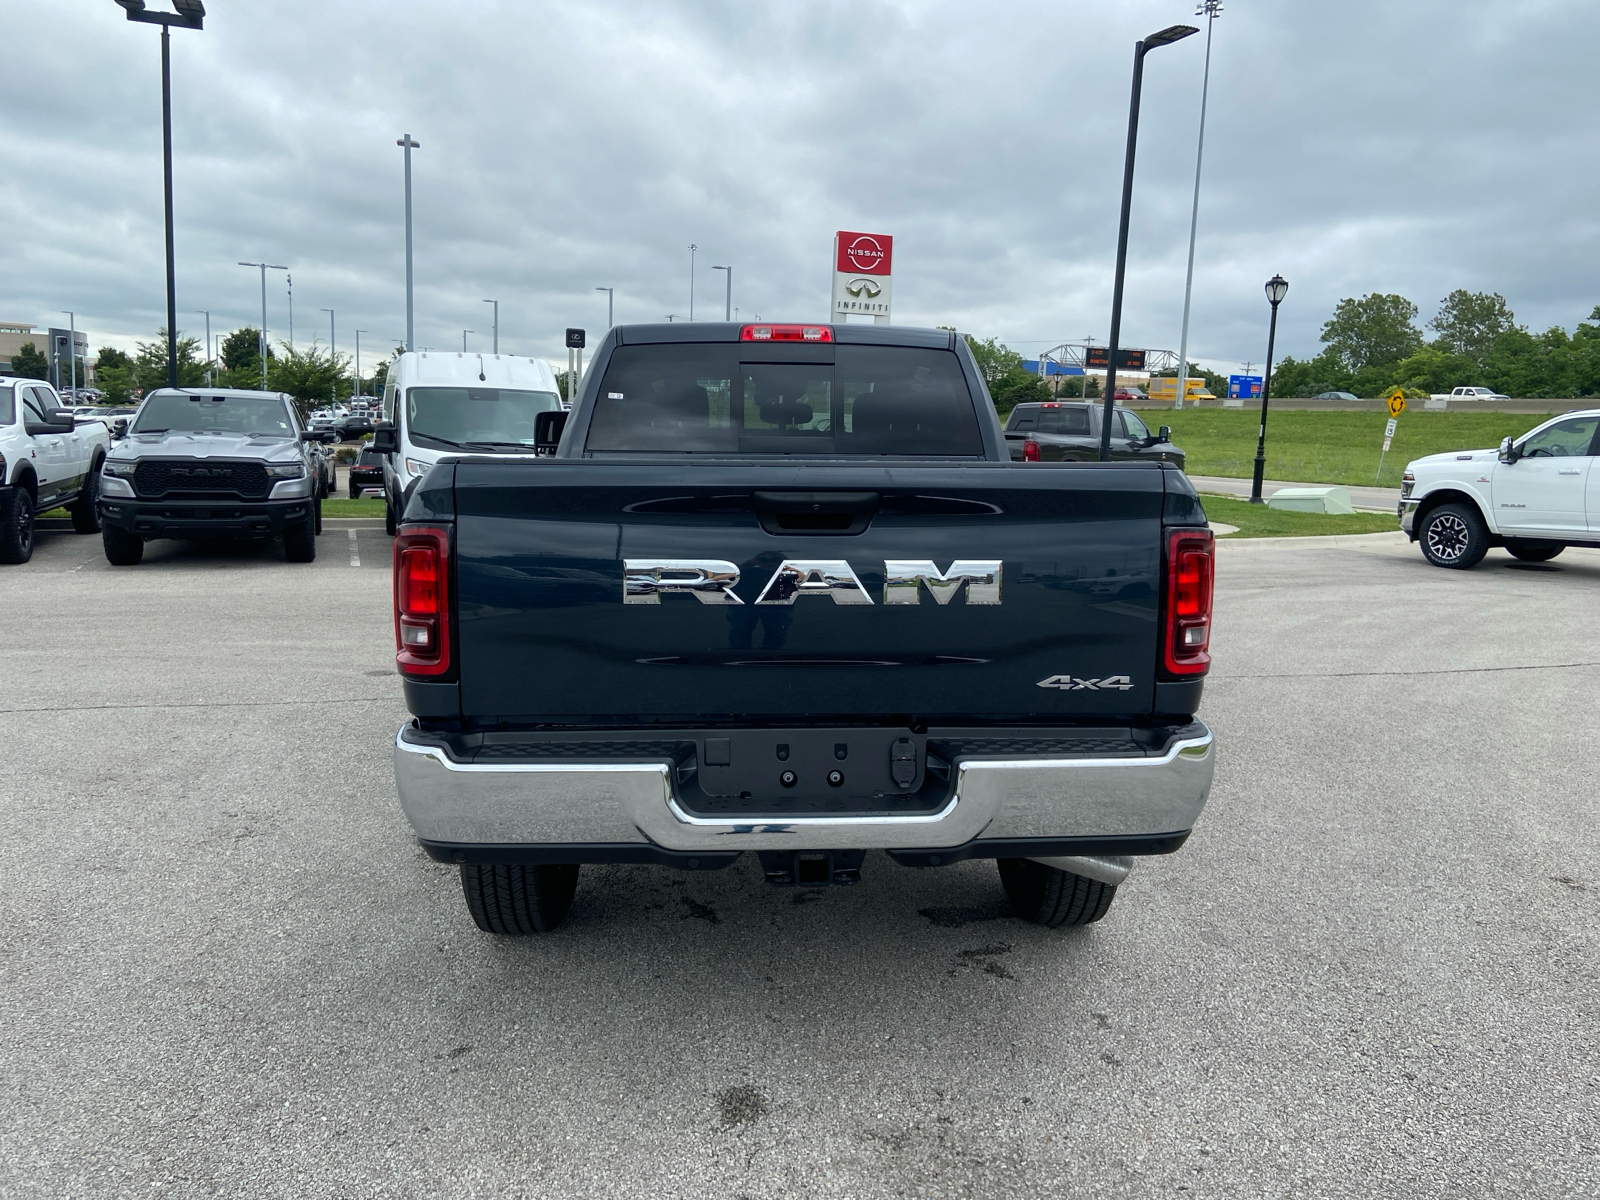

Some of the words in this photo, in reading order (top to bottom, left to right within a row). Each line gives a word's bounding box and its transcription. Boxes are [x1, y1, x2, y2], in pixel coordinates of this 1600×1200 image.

[847, 248, 884, 258] NISSAN
[837, 301, 888, 311] INFINITI
[170, 468, 232, 477] RAM
[623, 559, 1003, 605] RAM
[1036, 675, 1134, 690] 4x4
